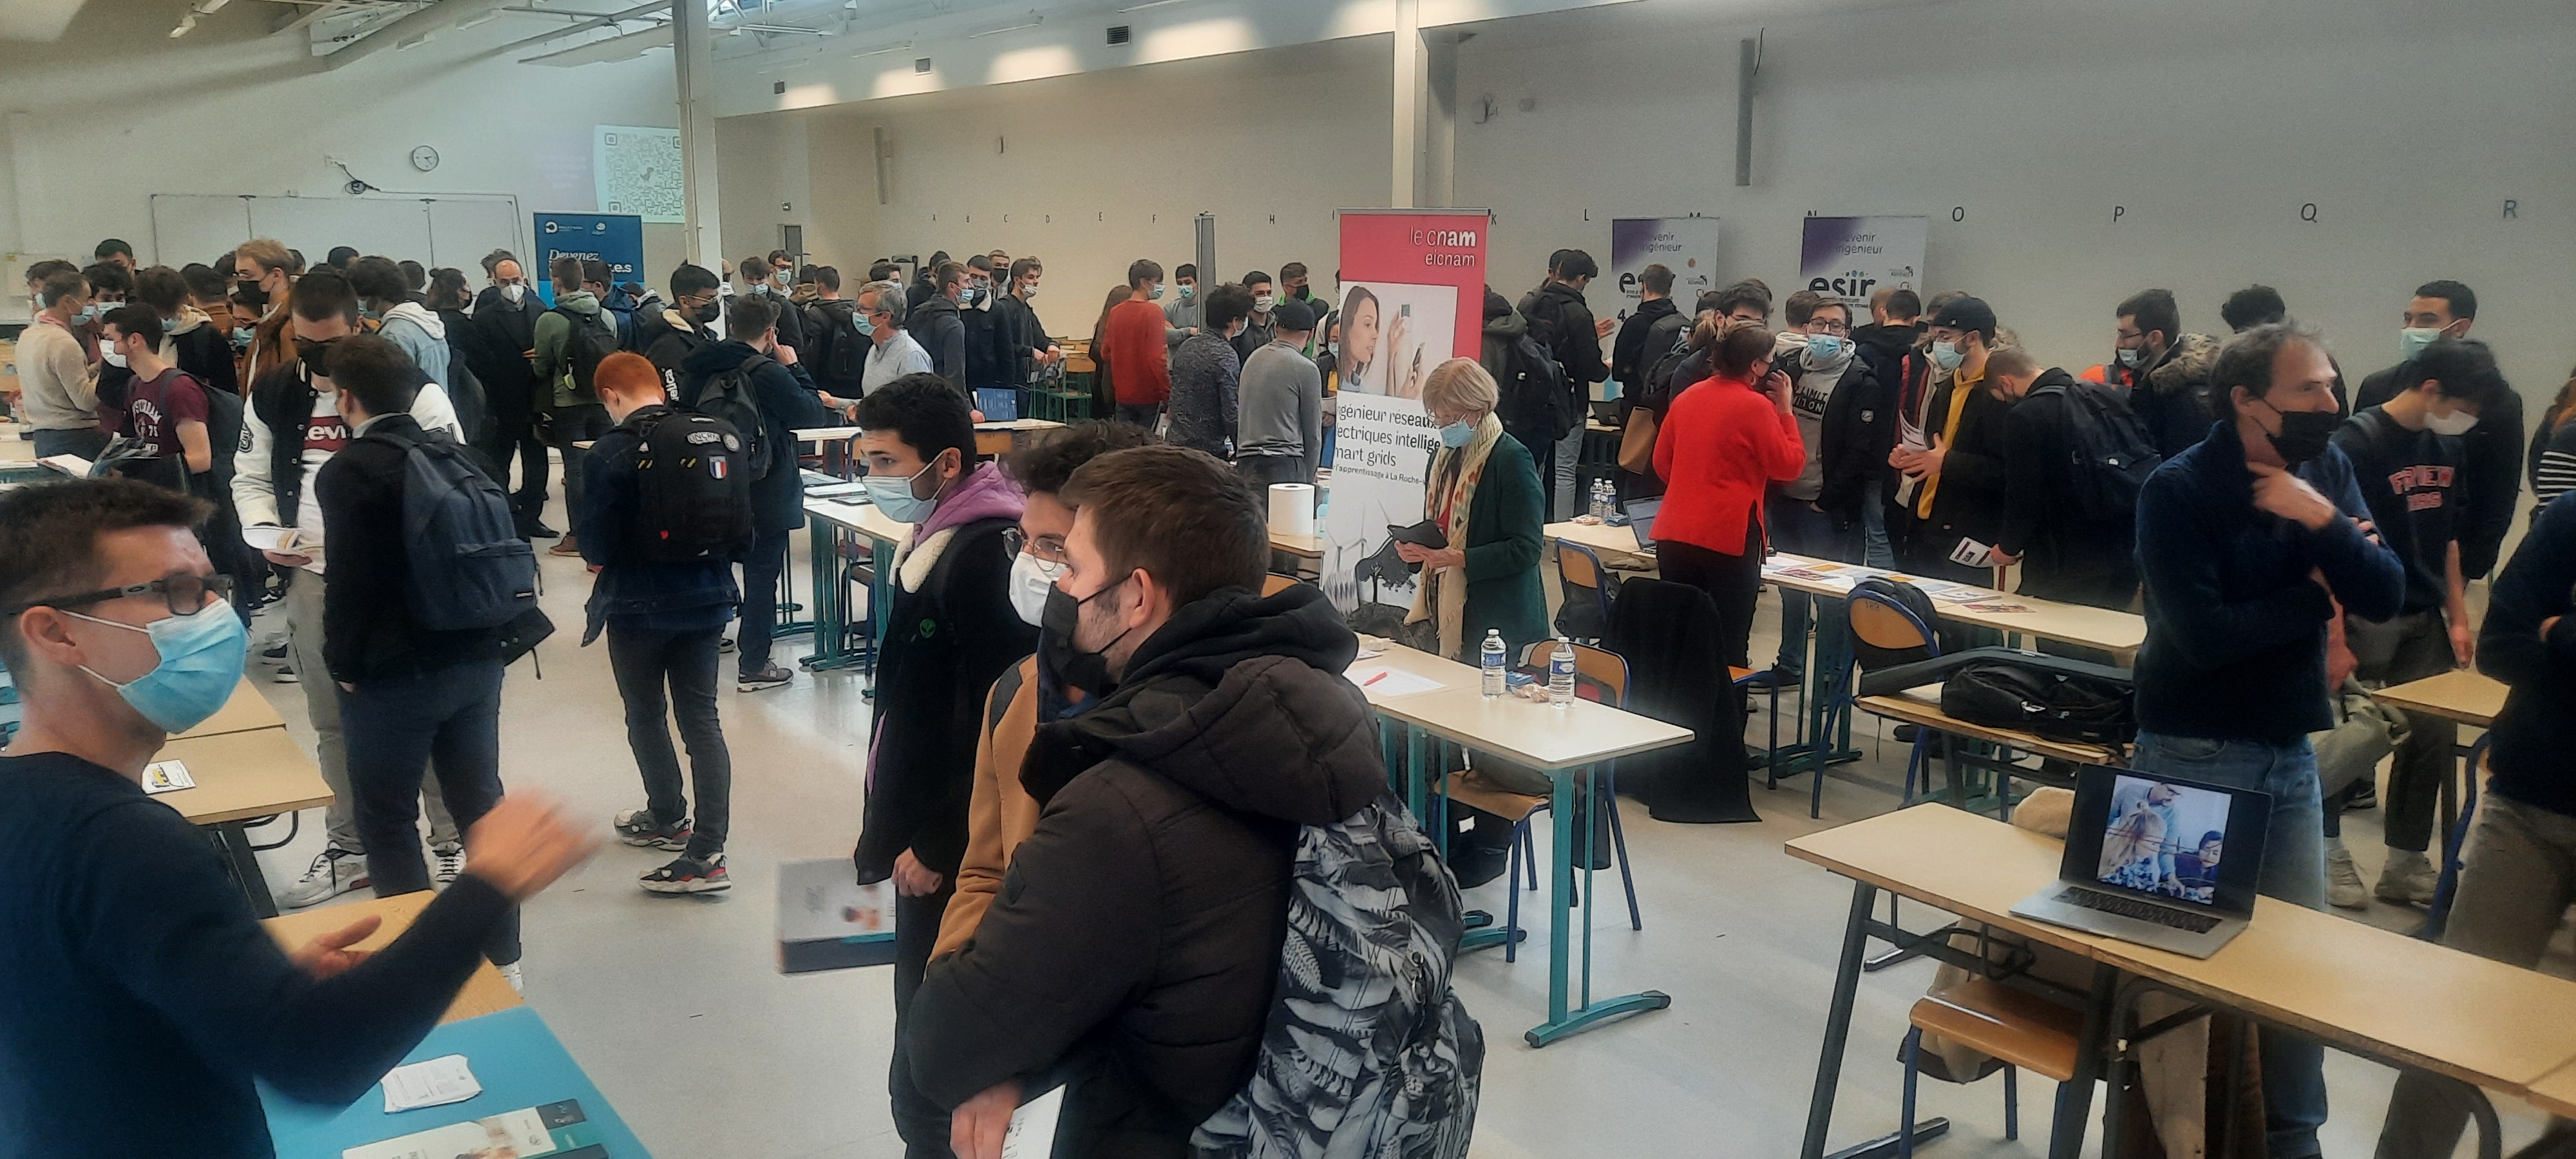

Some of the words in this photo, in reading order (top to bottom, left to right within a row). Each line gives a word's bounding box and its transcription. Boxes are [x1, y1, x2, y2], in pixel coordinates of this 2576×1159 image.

[1584, 209, 1589, 221] L
[1952, 206, 1964, 222] O
[2113, 205, 2125, 223] P
[2300, 203, 2318, 223] Q
[2503, 200, 2517, 218] R
[1492, 214, 1497, 225] K
[1410, 226, 1423, 245] le
[1426, 230, 1476, 247] cnam
[1425, 249, 1475, 267] eicnam
[1808, 277, 1877, 296] esir
[1337, 403, 1387, 422] ngénieur
[1396, 431, 1441, 454] intellige
[1367, 449, 1397, 466] grids
[1390, 472, 1397, 480] La
